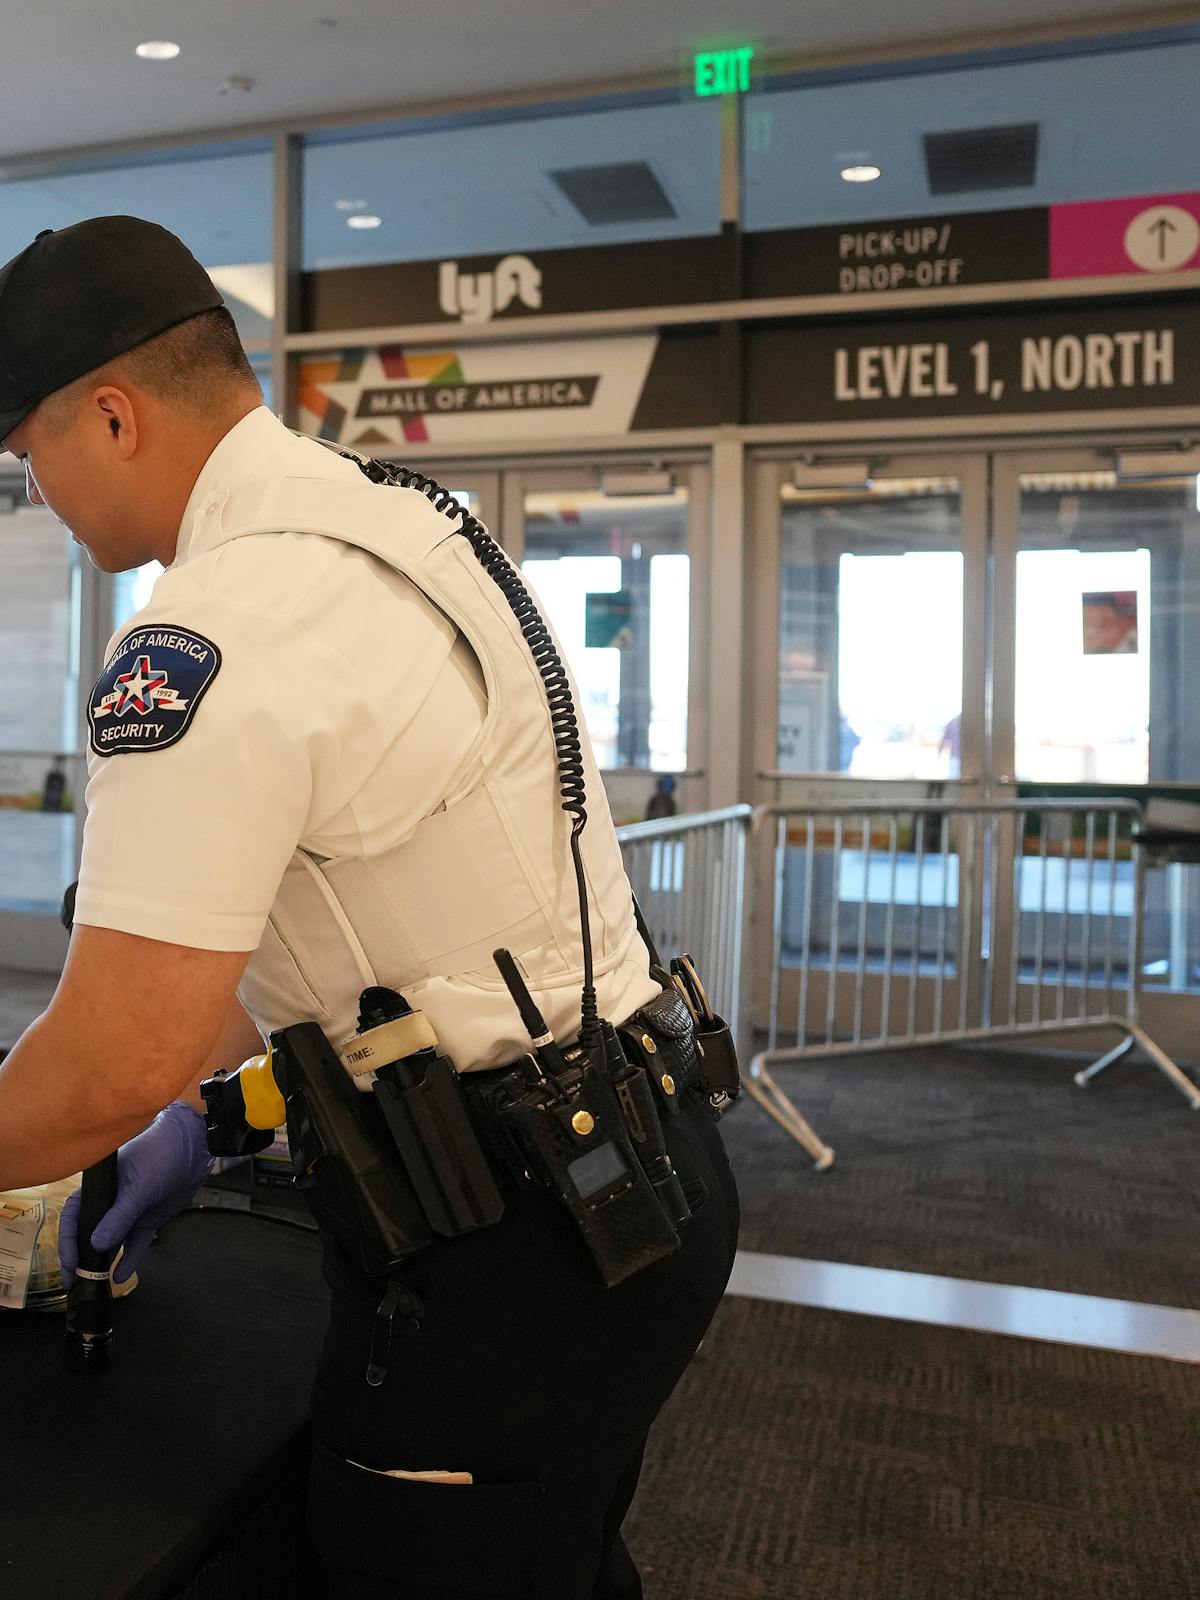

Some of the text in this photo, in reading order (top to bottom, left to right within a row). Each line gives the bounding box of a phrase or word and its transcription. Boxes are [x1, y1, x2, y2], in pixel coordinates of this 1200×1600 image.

[694, 46, 754, 97] EXIT
[839, 223, 952, 258] PICK-UP/
[438, 255, 543, 323] lyft
[839, 258, 964, 292] DROP-OFF
[834, 329, 1174, 401] LEVEL 1, NORTH
[370, 381, 585, 413] MALL OF AMERICA
[130, 634, 146, 651] OF
[145, 633, 208, 664] AMERICA
[156, 689, 173, 698] 1992
[100, 723, 164, 742] SECURITY
[346, 1046, 375, 1065] TIME:
